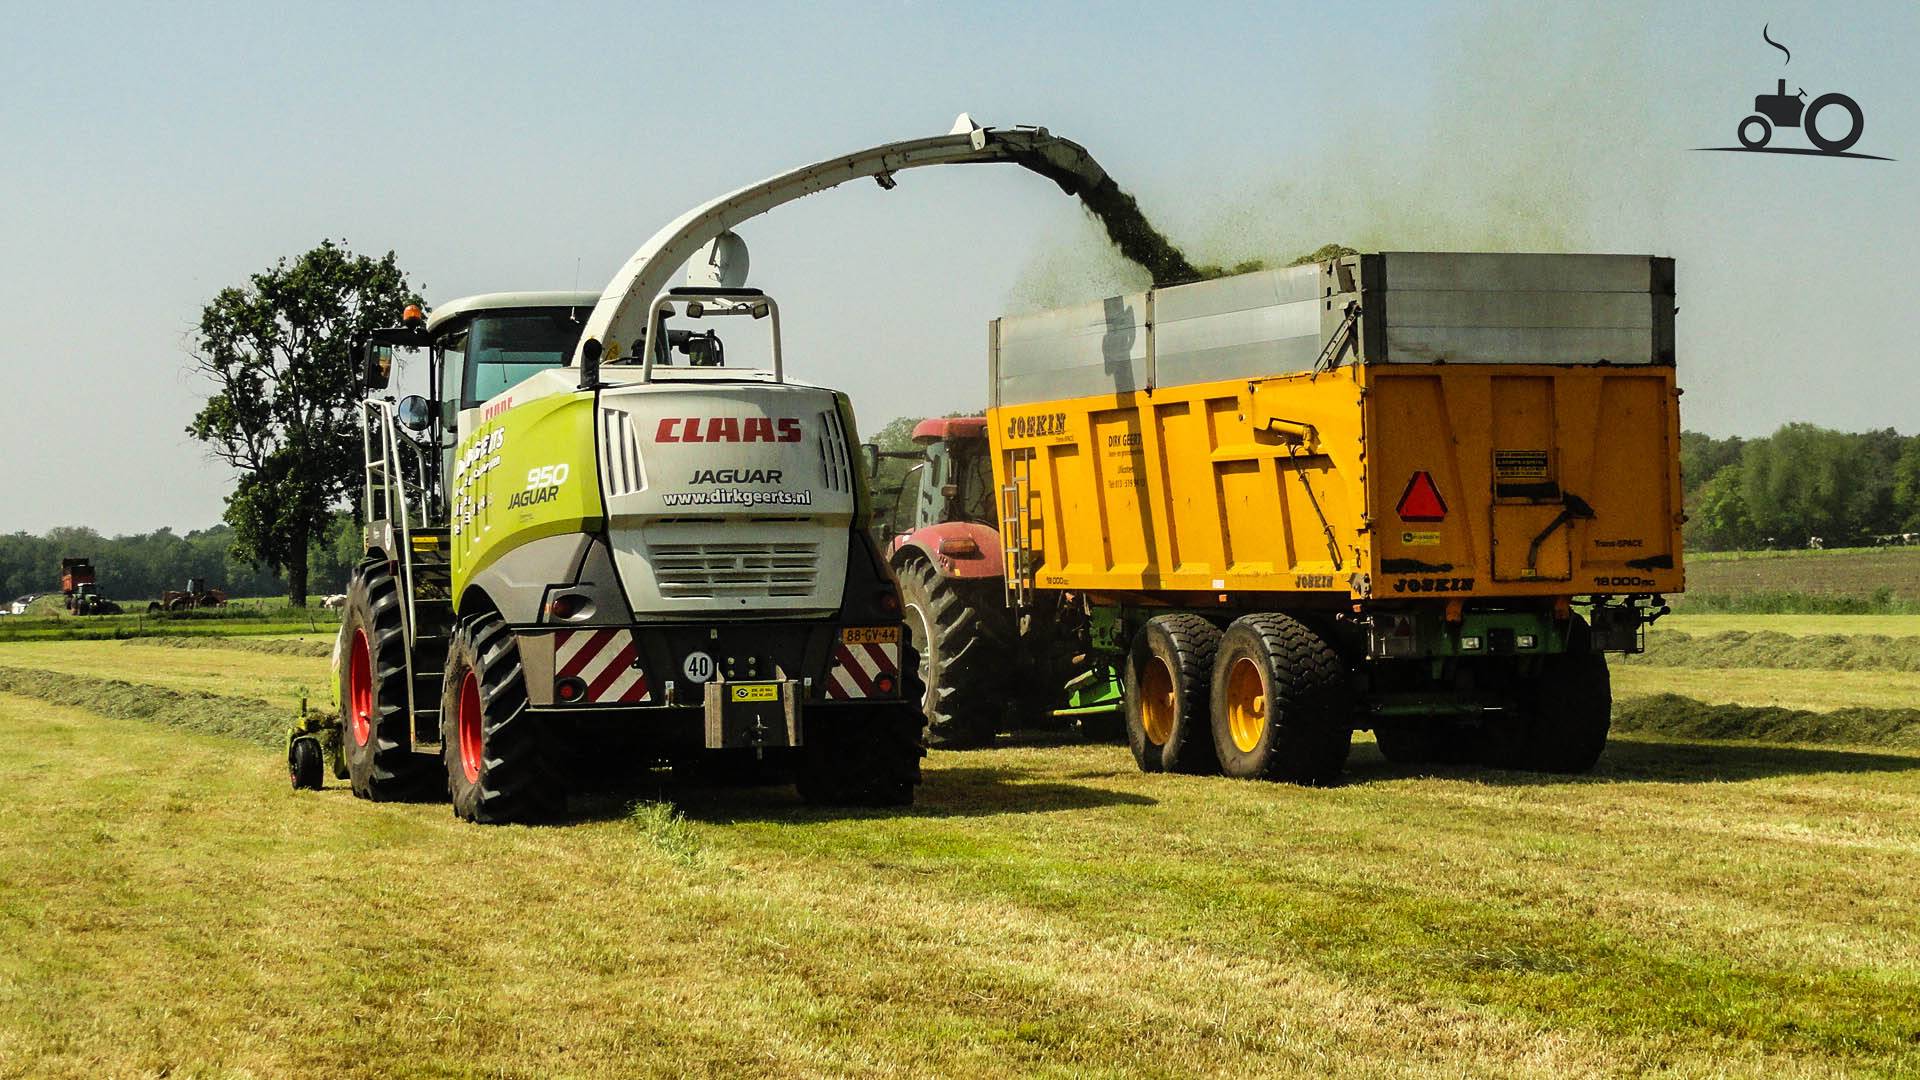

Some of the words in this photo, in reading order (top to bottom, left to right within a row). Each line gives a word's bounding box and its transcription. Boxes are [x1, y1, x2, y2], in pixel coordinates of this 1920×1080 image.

[655, 418, 801, 442] CLAAS
[1008, 413, 1066, 439] JOSKIN
[1108, 434, 1121, 448] DIRK
[526, 463, 569, 490] 950
[689, 469, 783, 484] JAGUAR
[508, 485, 559, 510] JAGUAR
[663, 489, 812, 507] www.dirkgeerts.nl
[1393, 577, 1475, 592] JOSKIN
[847, 629, 895, 642] 88-GV-44
[688, 656, 708, 677] 40
